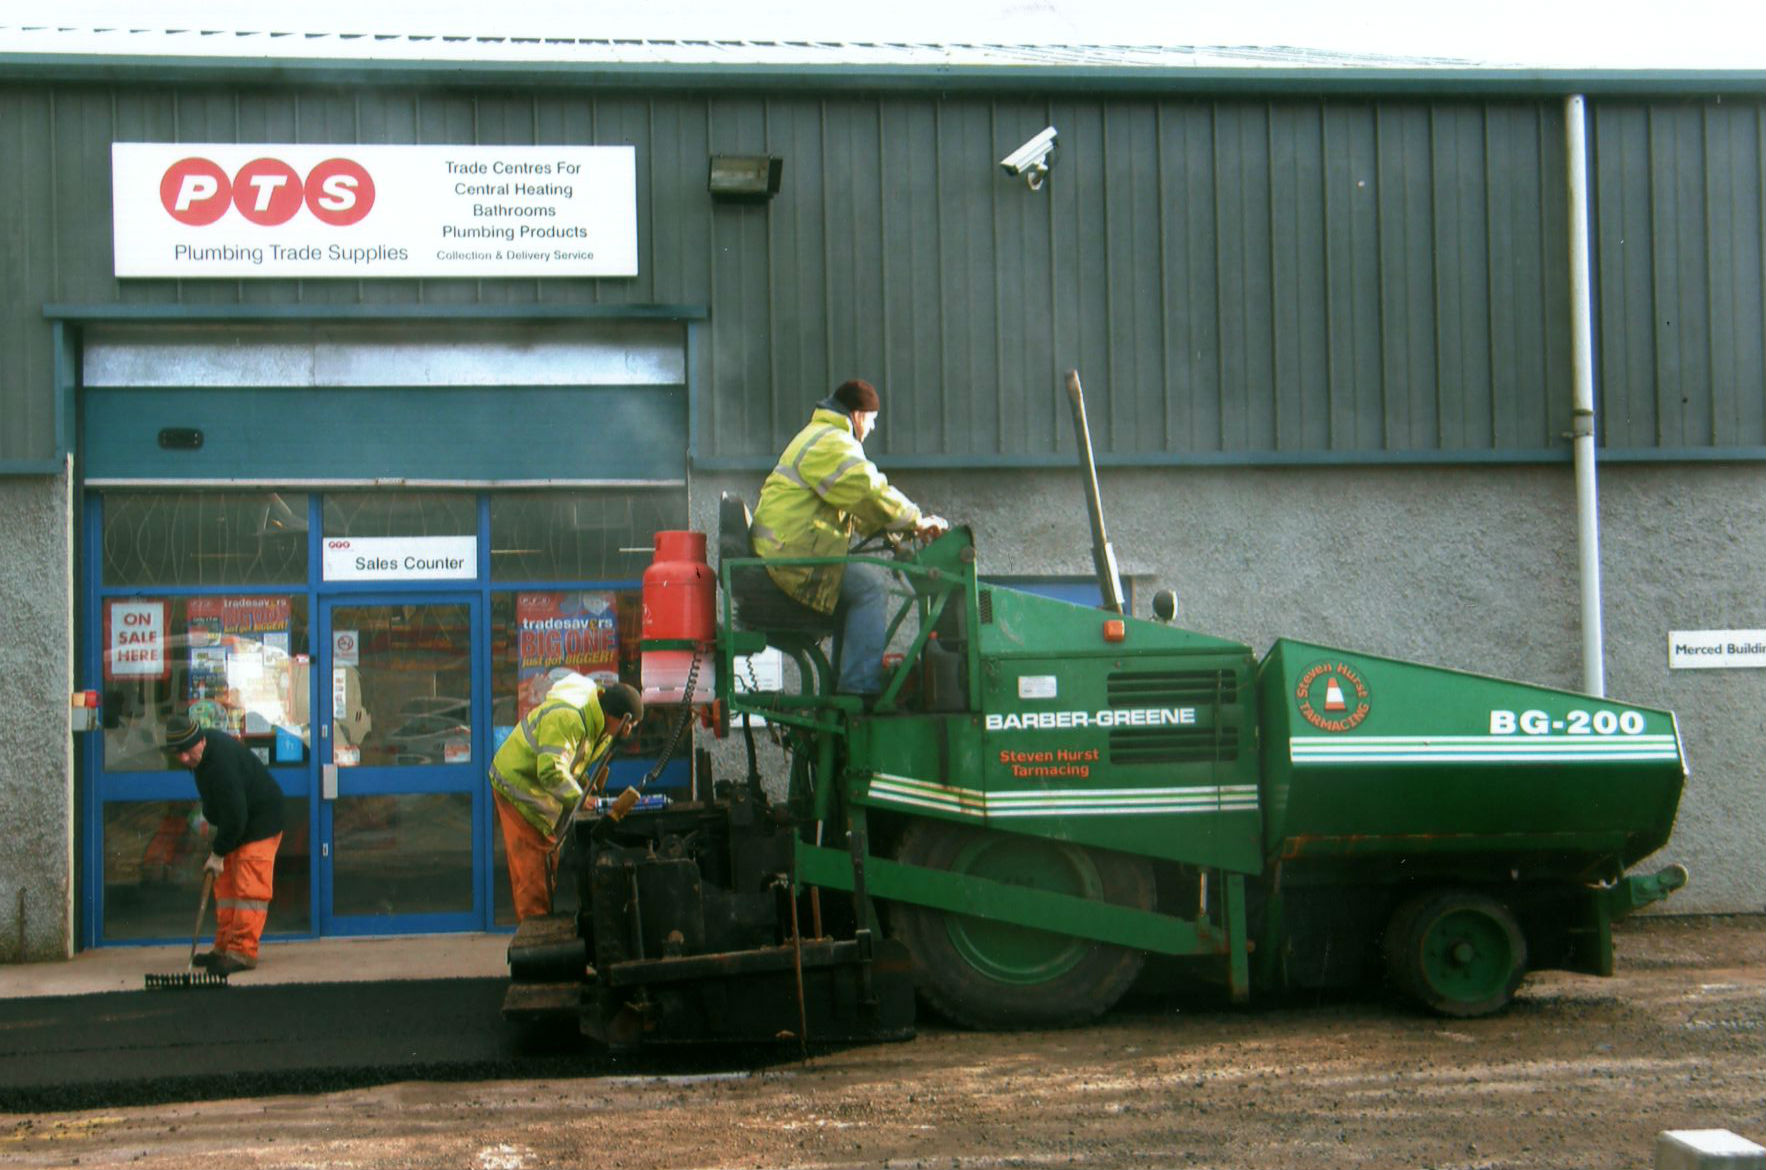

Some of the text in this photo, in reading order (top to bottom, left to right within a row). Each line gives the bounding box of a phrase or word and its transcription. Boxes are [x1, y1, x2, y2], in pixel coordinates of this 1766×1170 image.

[445, 161, 581, 174] Trade Centres For
[172, 172, 362, 213] PTS
[454, 182, 573, 199] Central Heating
[473, 204, 556, 217] Bathrooms
[442, 225, 588, 241] Plumbing Products
[174, 244, 409, 264] Plumbing Trade Supplies
[436, 249, 594, 263] Collection & Delivery Service
[355, 556, 465, 570] Sales Counter
[123, 612, 152, 626] ON
[118, 630, 157, 645] SALE
[520, 629, 616, 658] BIG ONE
[117, 649, 158, 662] HERE
[1675, 643, 1723, 655] Merced
[1296, 661, 1368, 698] Steven Hurst
[985, 708, 1196, 730] BARBER-GREENE
[1299, 700, 1369, 731] TARMACING
[1489, 710, 1645, 735] BG-200
[1000, 748, 1099, 762] Steven Hurst
[1012, 763, 1090, 778] Tarmacing
